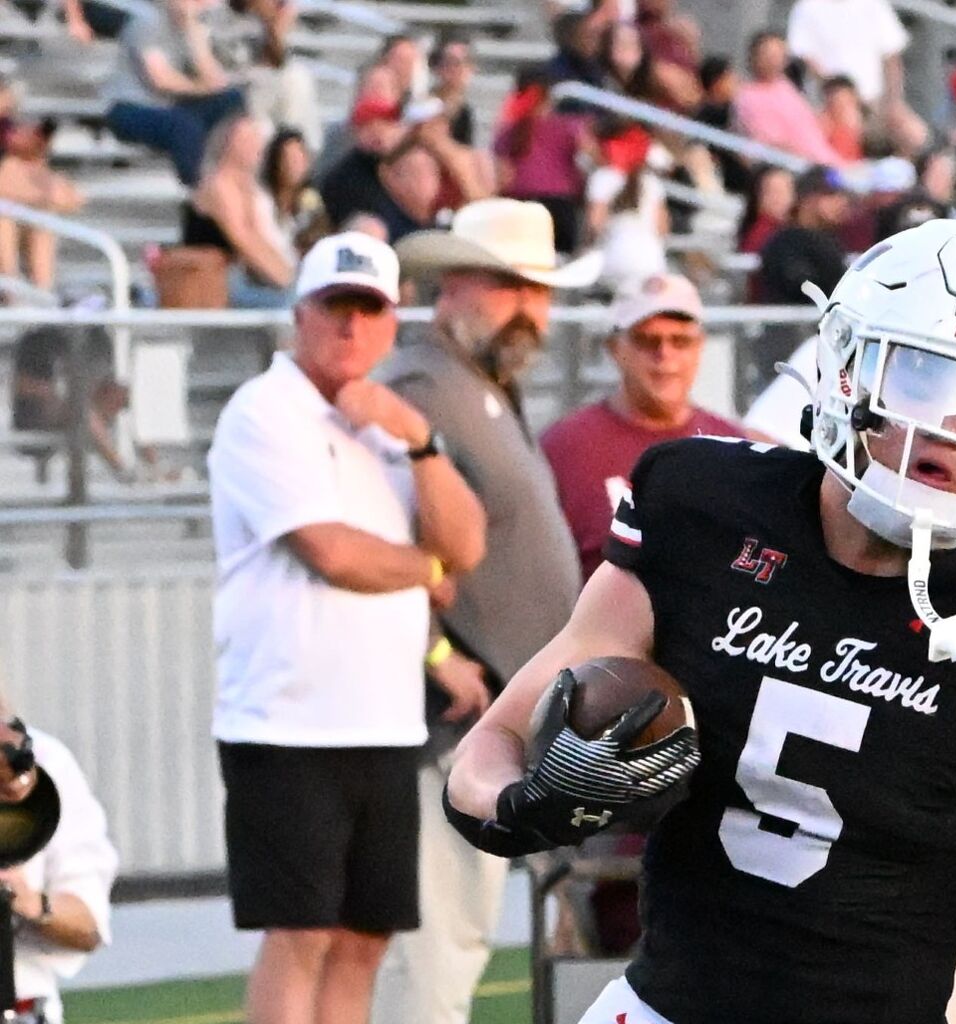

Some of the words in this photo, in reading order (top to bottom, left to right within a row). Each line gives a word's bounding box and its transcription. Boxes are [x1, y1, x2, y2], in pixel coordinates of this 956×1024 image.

[730, 537, 788, 585] LT
[711, 606, 812, 672] Lake
[820, 637, 941, 715] Travis
[718, 675, 872, 889] 5
